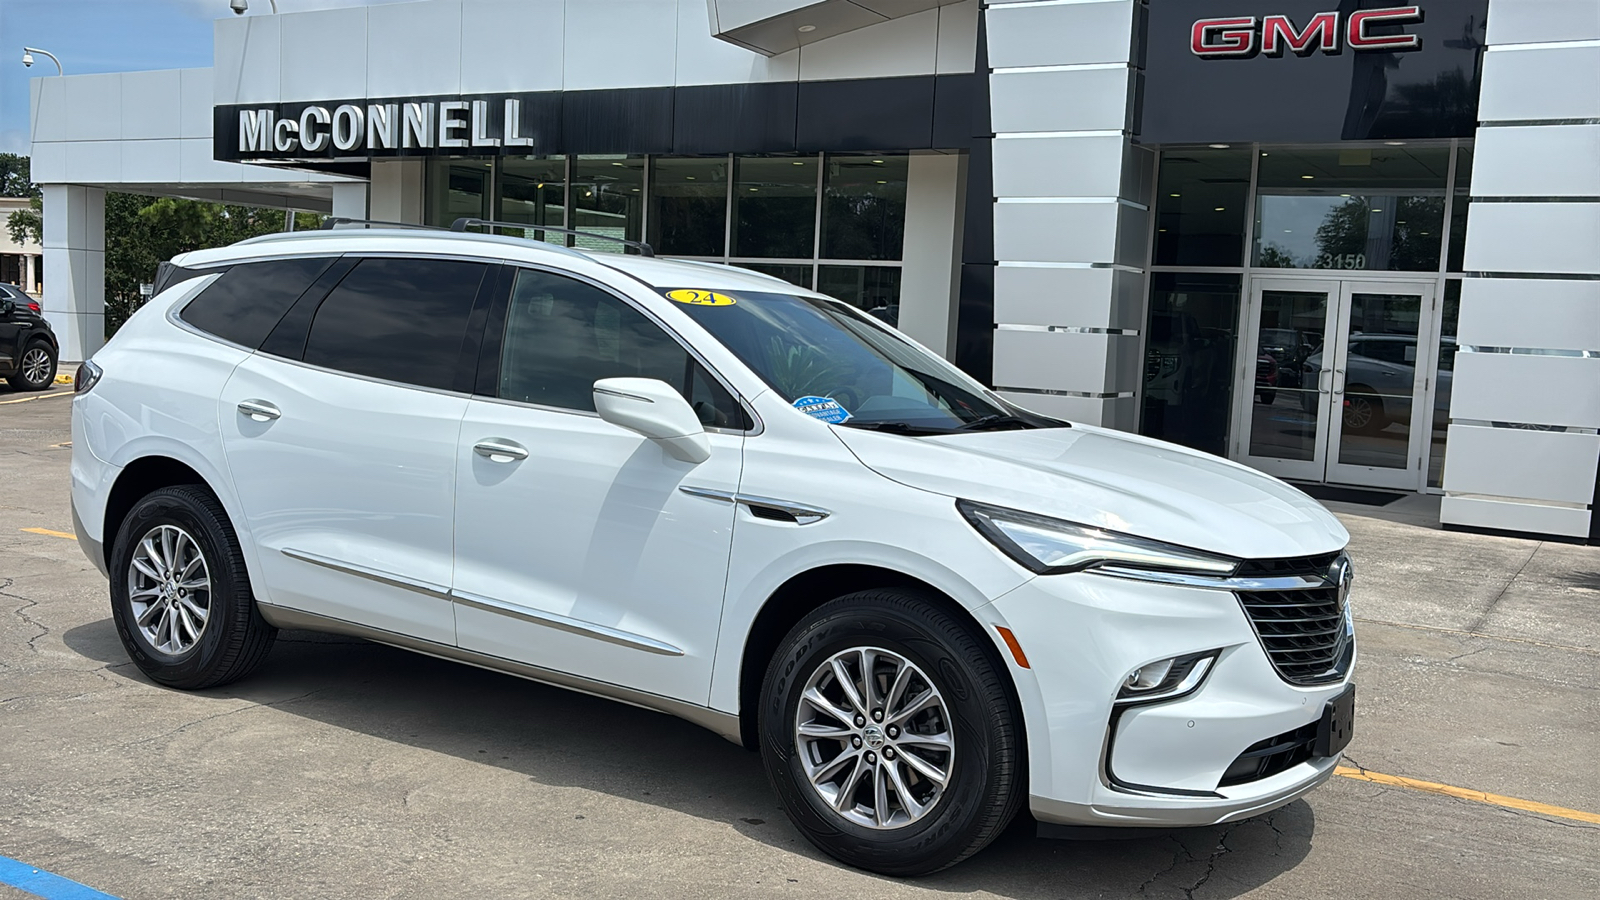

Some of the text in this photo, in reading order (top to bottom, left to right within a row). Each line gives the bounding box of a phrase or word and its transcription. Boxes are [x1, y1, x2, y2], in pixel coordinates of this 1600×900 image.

[1191, 6, 1422, 57] GMC
[239, 98, 534, 152] McCONNELL
[1322, 253, 1366, 269] 3150
[686, 291, 717, 304] 24
